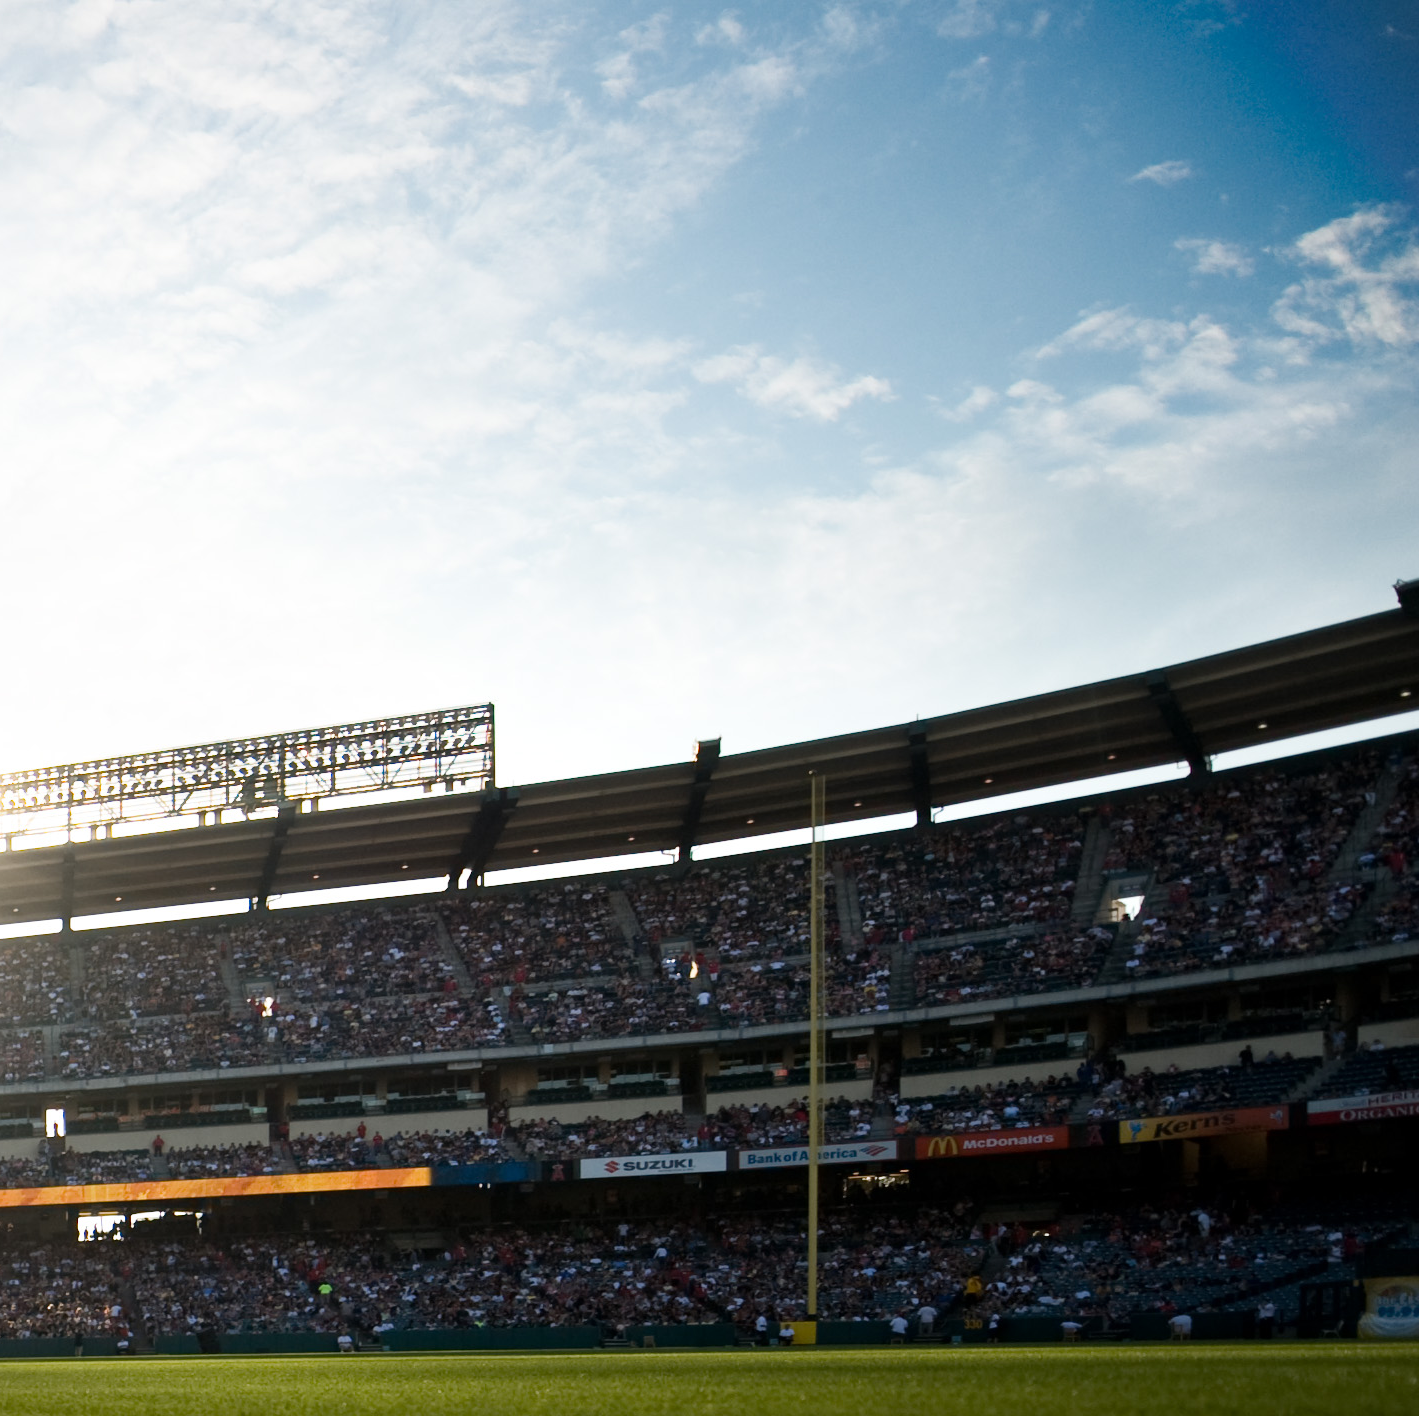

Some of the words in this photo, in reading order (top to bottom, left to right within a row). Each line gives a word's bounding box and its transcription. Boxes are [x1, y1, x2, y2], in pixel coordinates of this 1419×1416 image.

[1368, 1091, 1419, 1106] HERIT
[963, 1134, 1055, 1149] McDonald's
[747, 1153, 782, 1164] Bank
[783, 1151, 797, 1162] of
[799, 1148, 858, 1161] Aerica
[623, 1159, 693, 1171] SUZUKI
